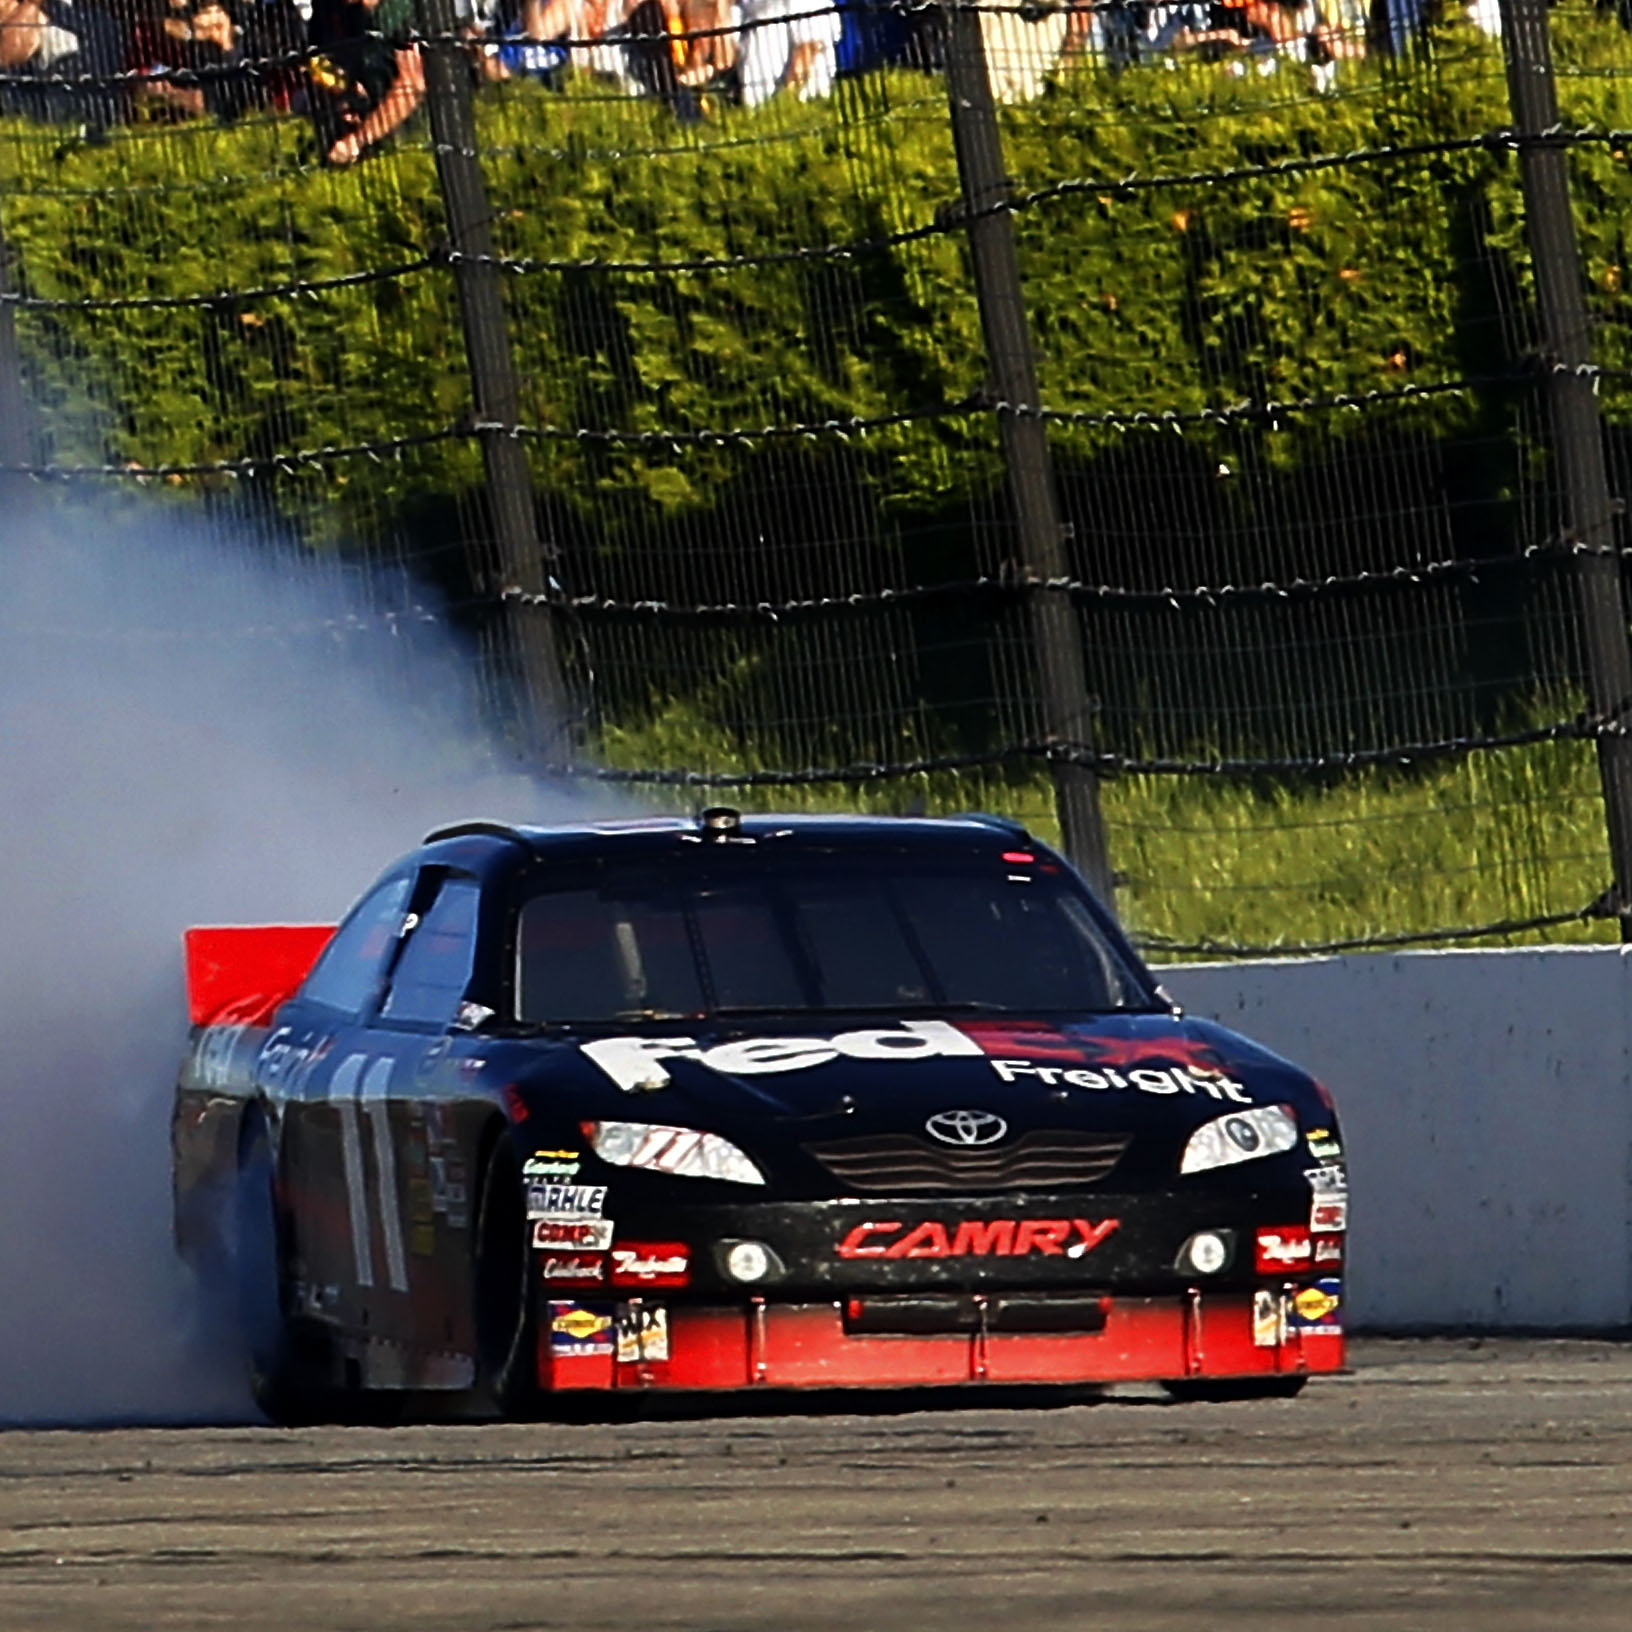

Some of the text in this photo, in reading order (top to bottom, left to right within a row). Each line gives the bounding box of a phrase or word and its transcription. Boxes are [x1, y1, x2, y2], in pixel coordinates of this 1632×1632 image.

[579, 1020, 1243, 1092] FedEx
[990, 1060, 1254, 1104] Freight
[328, 1053, 409, 1293] 11
[837, 1218, 1121, 1260] CAMRY
